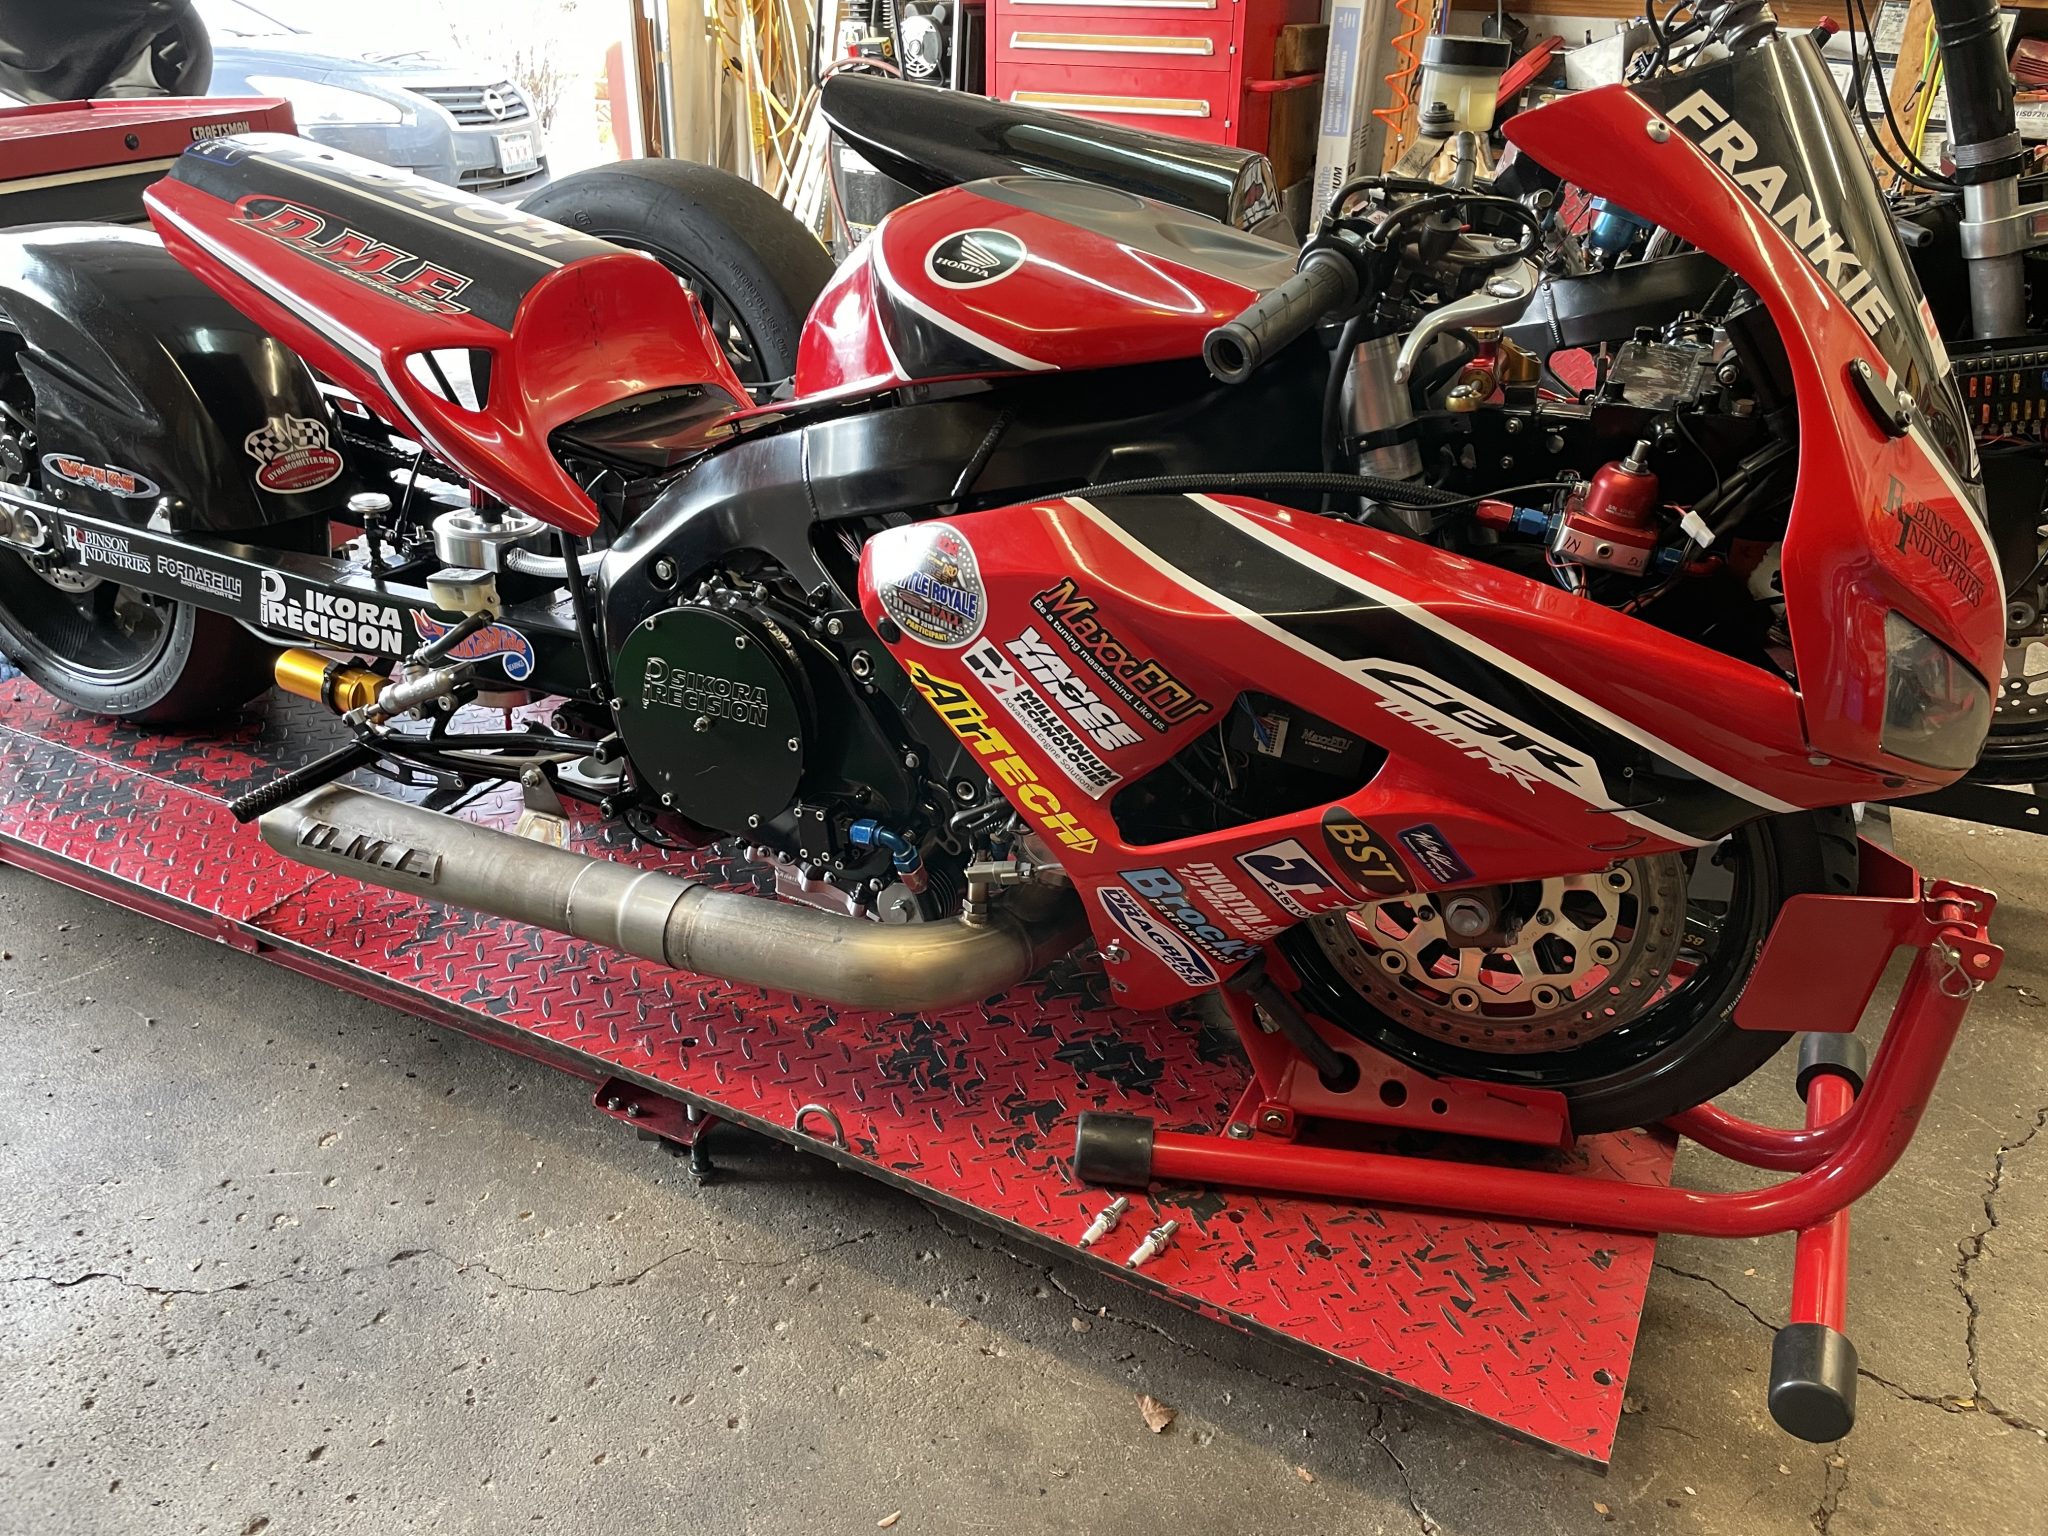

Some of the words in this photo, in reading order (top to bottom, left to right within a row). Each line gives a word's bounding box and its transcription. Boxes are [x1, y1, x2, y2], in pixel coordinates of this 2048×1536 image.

[192, 121, 250, 141] CRAFTSMAN
[1666, 89, 1896, 336] FRANKIE
[936, 257, 989, 277] HONDA
[267, 456, 334, 480] DYNAMOMETER.COM
[79, 543, 151, 574] INDUSTRIES
[930, 581, 979, 621] ROYALE
[1895, 511, 1984, 608] INDUSTRIES
[906, 618, 948, 642] PARTICIPANT
[1034, 599, 1047, 615] Be
[1046, 614, 1054, 623] a
[1053, 621, 1080, 652] tuning
[1080, 650, 1132, 705] mastermind.
[1133, 701, 1154, 720] Like
[1152, 717, 1166, 731] us.
[1004, 638, 1123, 751] HINES
[1019, 627, 1144, 744] VANCE
[1361, 668, 1585, 788] CBR
[907, 661, 1096, 848] AirTECH
[1003, 697, 1038, 734] Advanced
[1037, 733, 1061, 761] Engine
[1060, 759, 1095, 792] Solutions
[1013, 694, 1110, 787] TECHNOLOGIES
[1021, 688, 1122, 784] MILLENNIUM
[1264, 881, 1311, 918] PISTO
[1325, 824, 1405, 883] BST
[1101, 888, 1210, 984] DRAGBIKE
[1148, 898, 1236, 964] PERFORMANCE
[1684, 932, 1705, 946] BS
